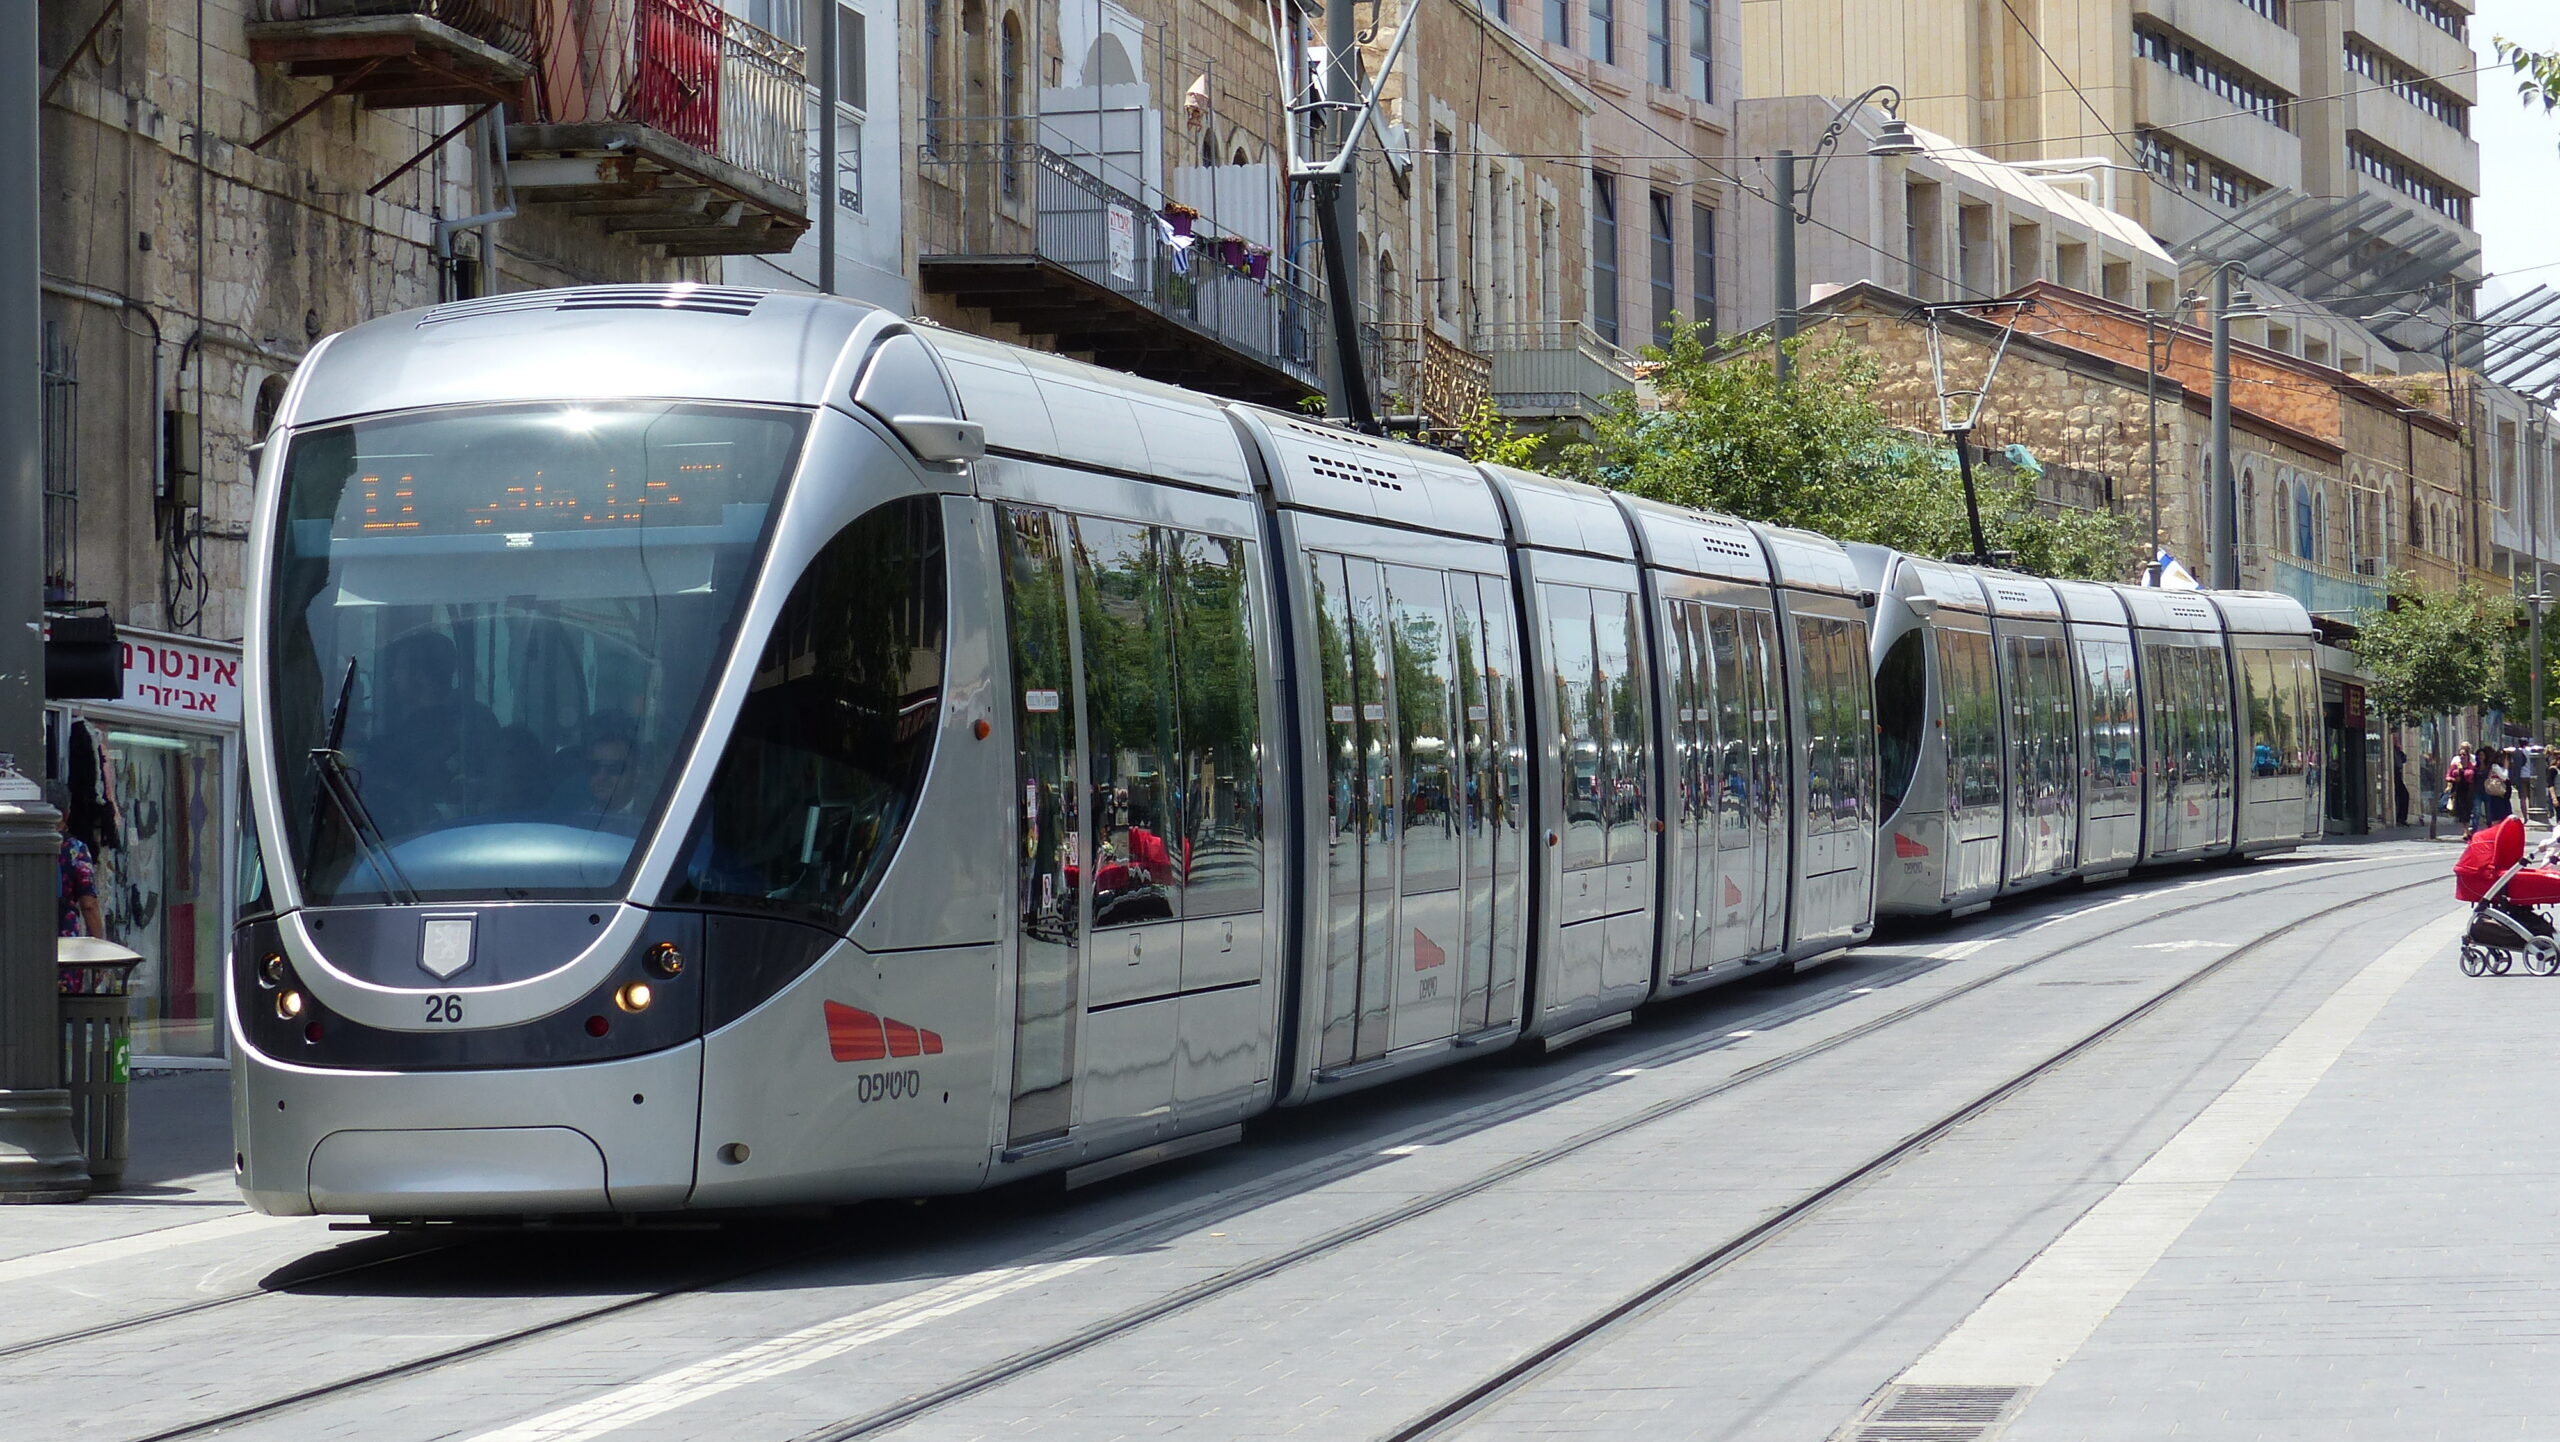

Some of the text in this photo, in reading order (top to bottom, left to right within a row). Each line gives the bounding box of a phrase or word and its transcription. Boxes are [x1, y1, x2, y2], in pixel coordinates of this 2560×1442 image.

[139, 684, 216, 712] אביזרי
[425, 994, 463, 1023] 26
[858, 1070, 920, 1103] סיטיפס
